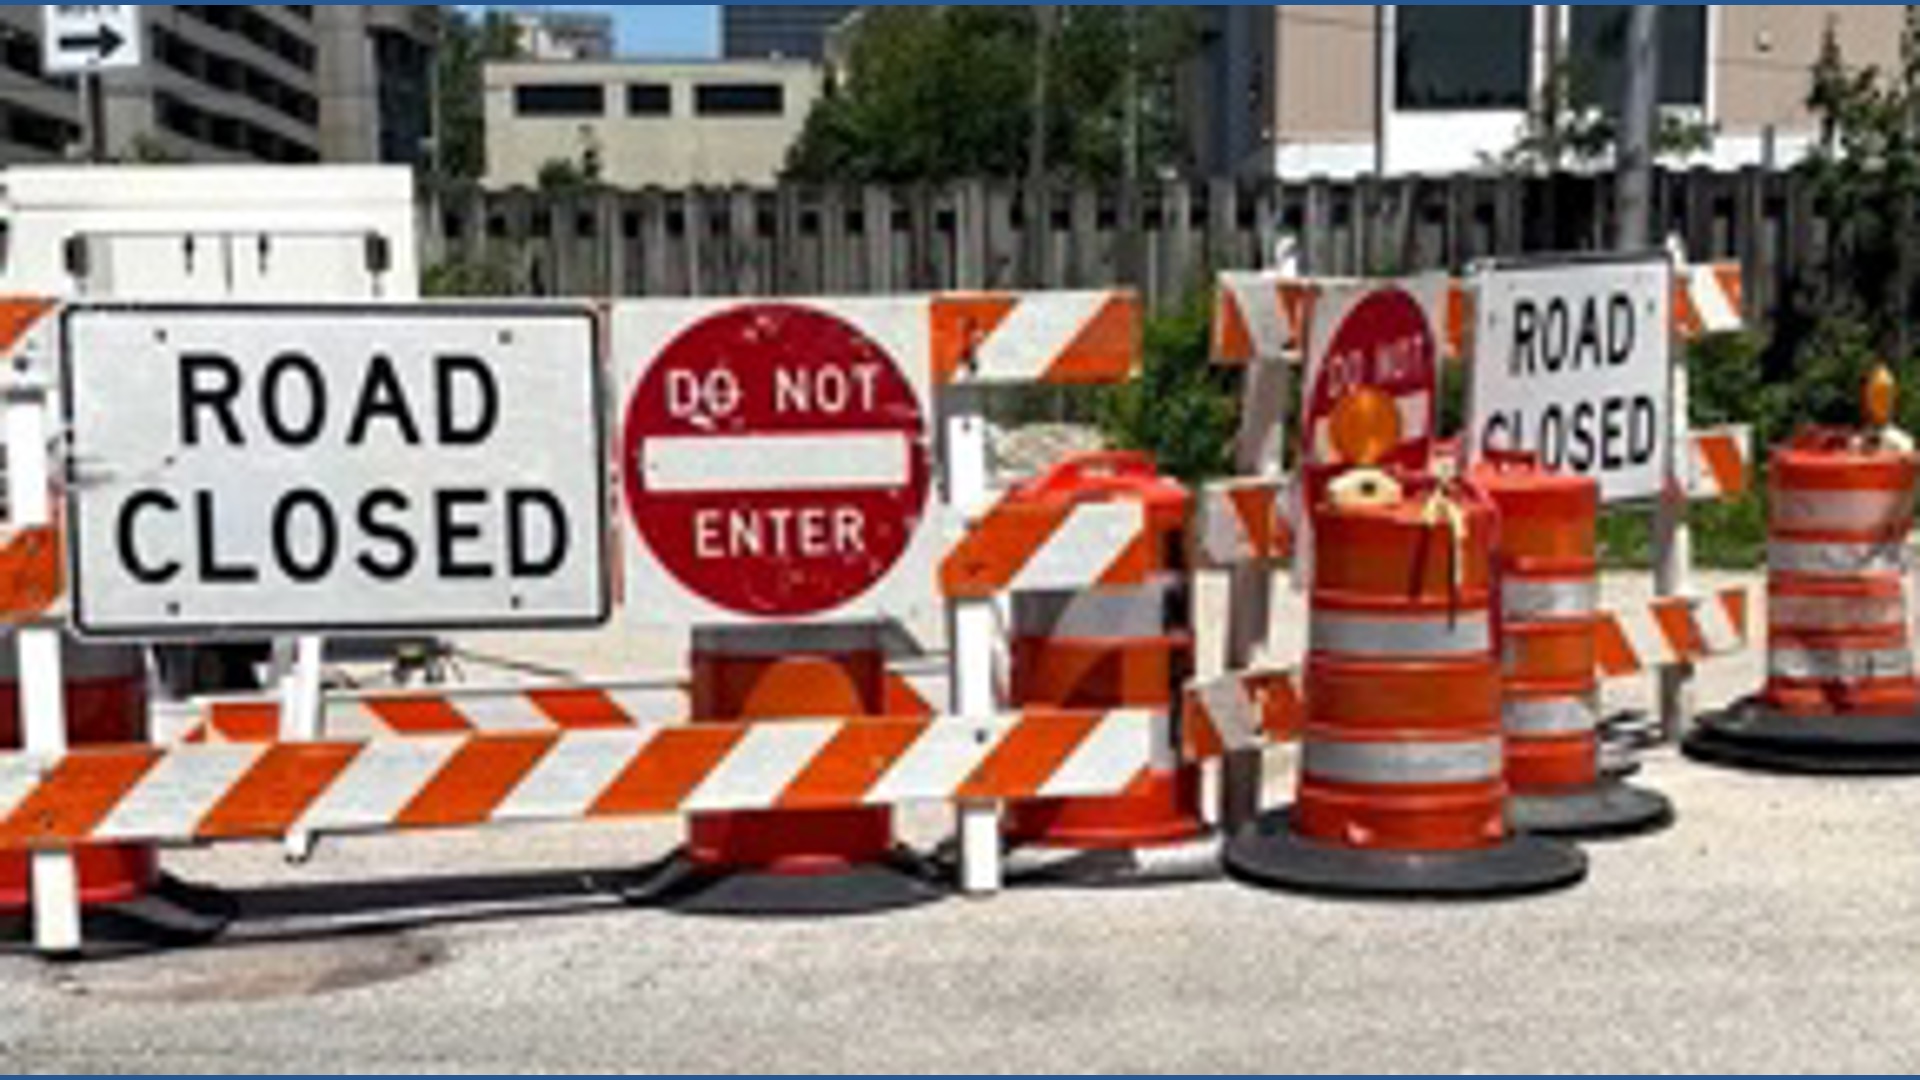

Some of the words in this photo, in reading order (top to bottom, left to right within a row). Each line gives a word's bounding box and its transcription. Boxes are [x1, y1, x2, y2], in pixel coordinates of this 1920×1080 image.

[1508, 292, 1635, 376] ROAD
[178, 353, 500, 447] ROAD
[667, 368, 740, 417] DO
[774, 362, 881, 413] NOT
[116, 488, 570, 583] CLOSED
[695, 507, 866, 558] ENTER
